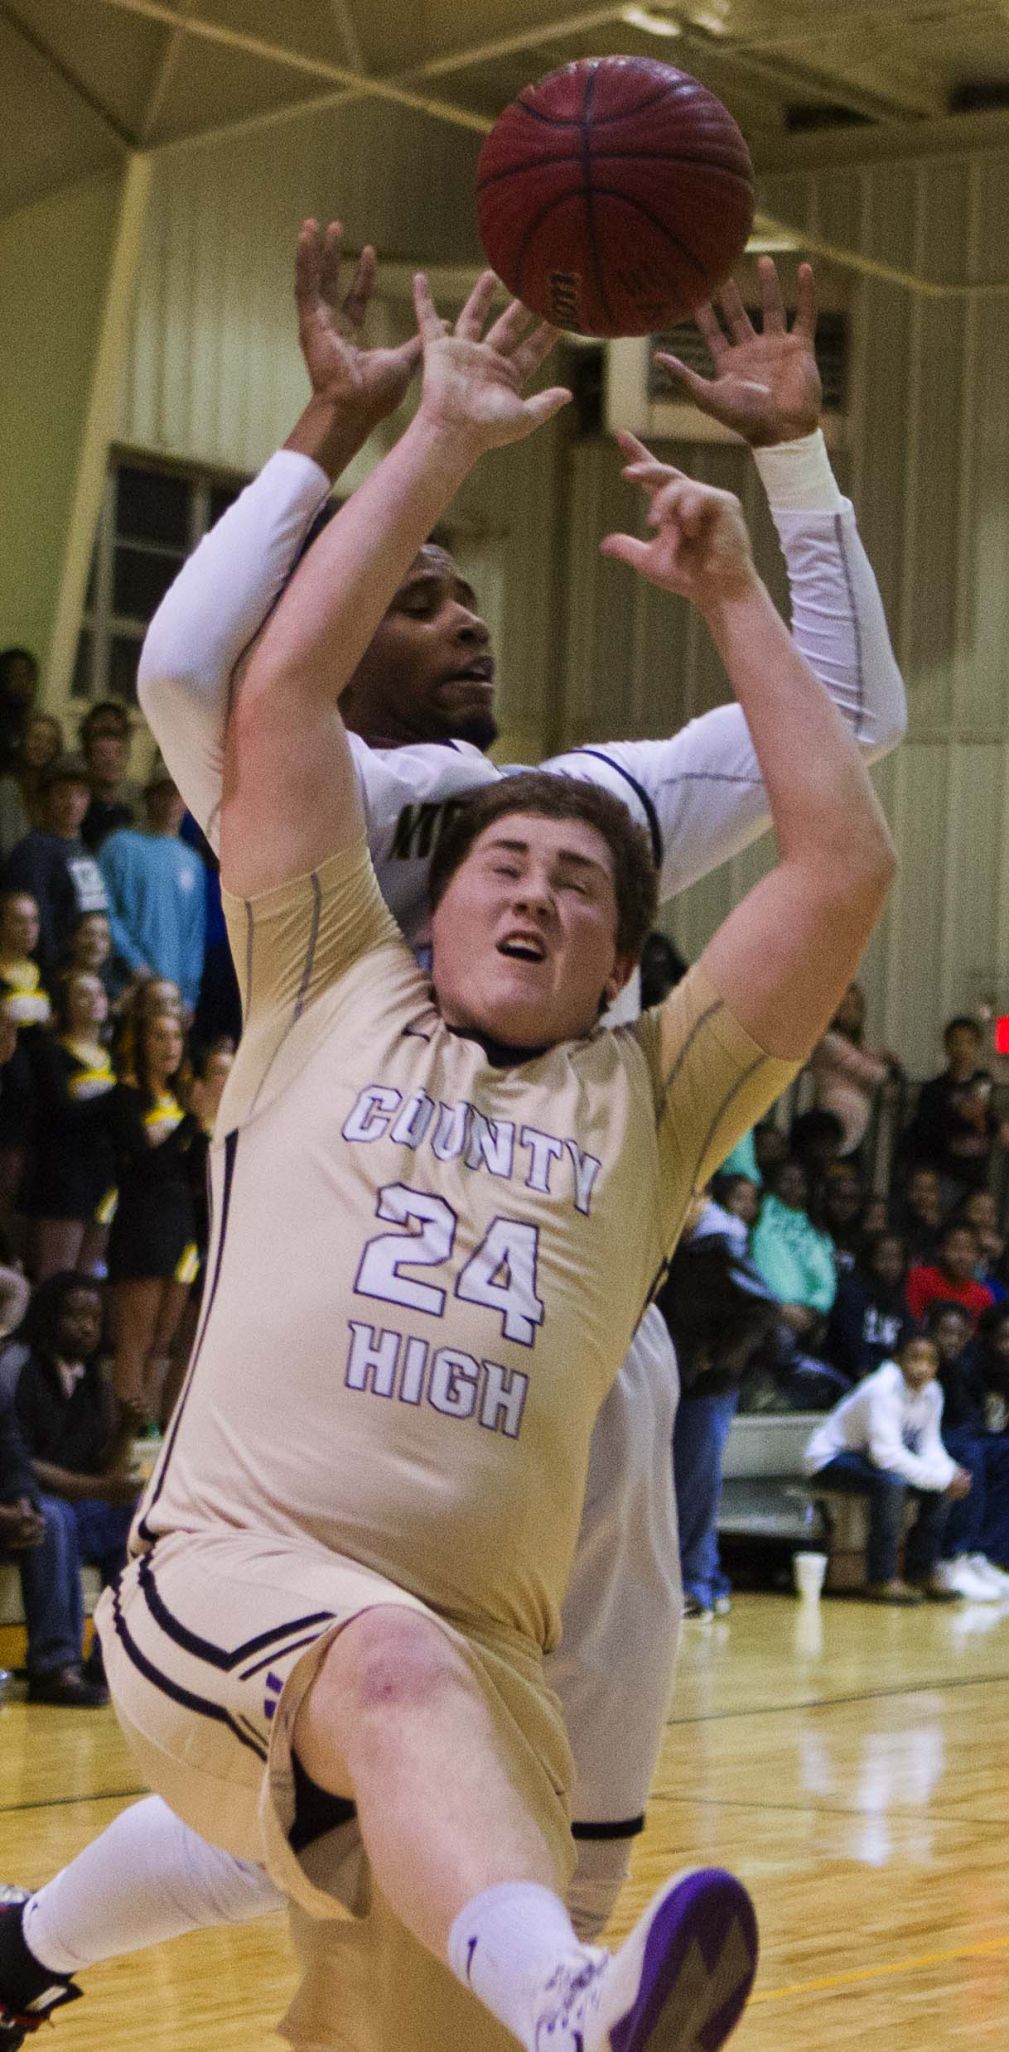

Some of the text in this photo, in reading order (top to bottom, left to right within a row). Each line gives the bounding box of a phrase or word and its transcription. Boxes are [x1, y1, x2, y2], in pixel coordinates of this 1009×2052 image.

[342, 1084, 601, 1216] COUNTY
[353, 1182, 544, 1348] 24
[345, 1320, 529, 1440] HIGH
